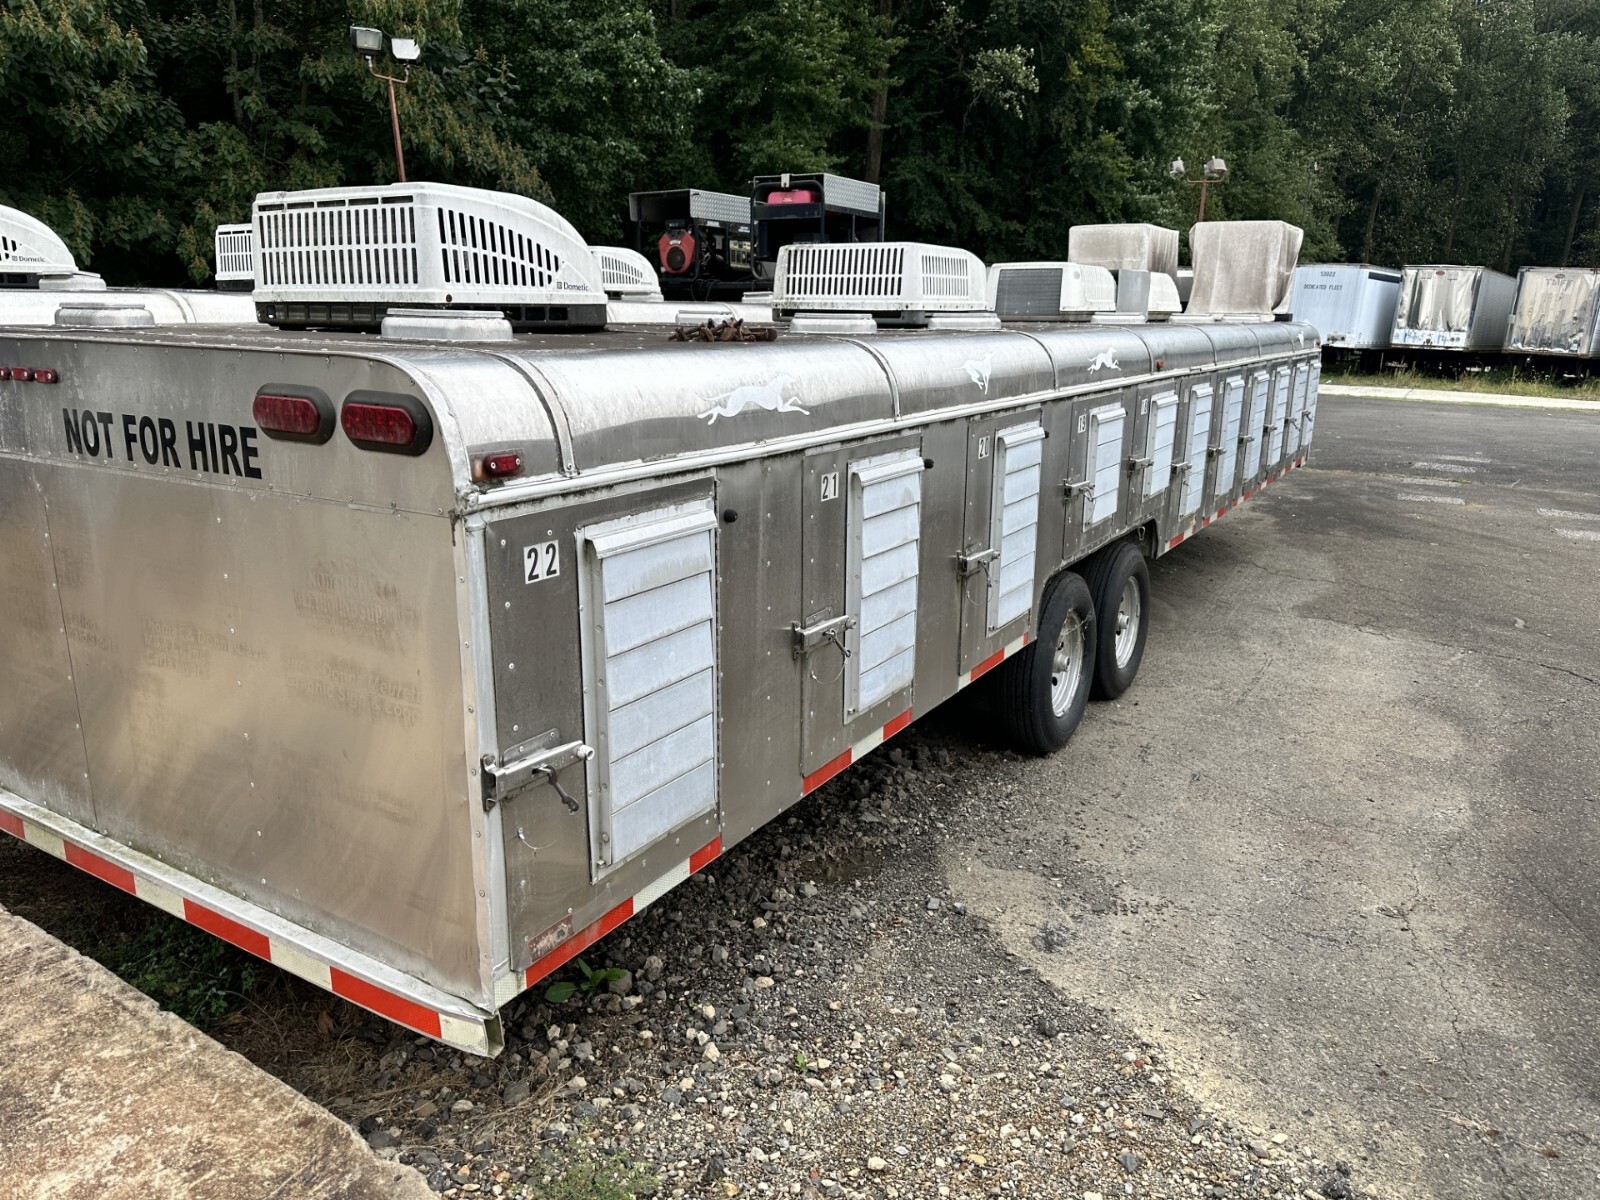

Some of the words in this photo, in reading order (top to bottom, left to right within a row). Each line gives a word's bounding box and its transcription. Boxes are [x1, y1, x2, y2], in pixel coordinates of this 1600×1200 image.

[18, 255, 46, 263] Dometic
[563, 281, 589, 291] Dometic
[1303, 283, 1327, 291] DEDICATED
[62, 408, 114, 459] NOT
[121, 413, 182, 469] FOR
[186, 420, 263, 480] HIRE
[978, 437, 990, 459] 20
[821, 472, 838, 500] 21
[526, 542, 558, 582] 22
